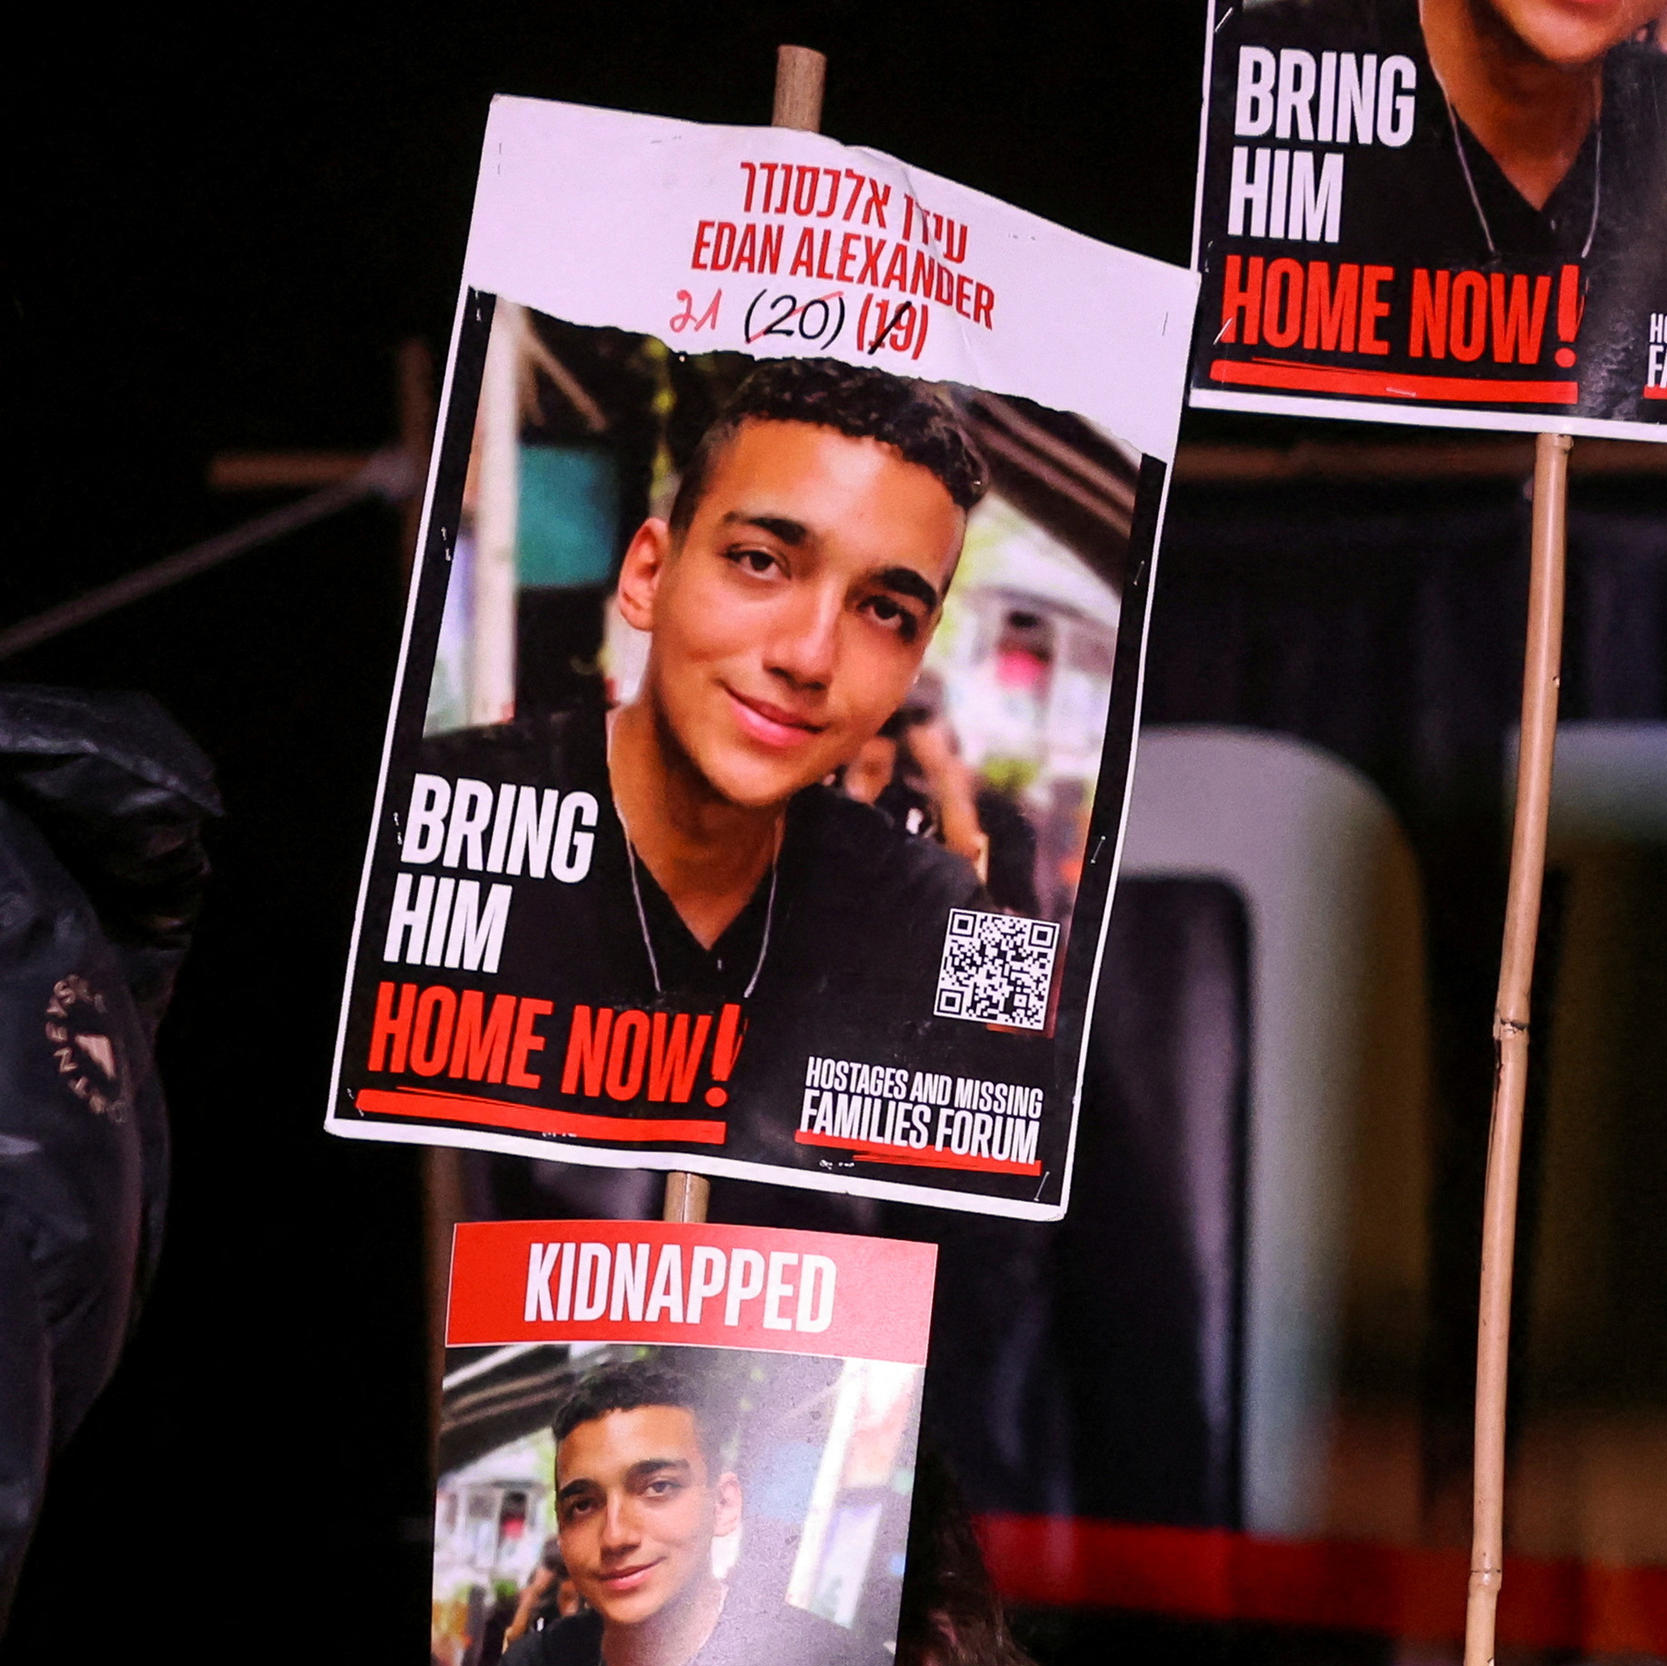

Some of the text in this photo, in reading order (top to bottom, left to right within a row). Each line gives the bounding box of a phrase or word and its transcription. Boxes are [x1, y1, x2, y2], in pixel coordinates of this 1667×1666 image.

[1233, 45, 1417, 147] BRING
[740, 161, 968, 265] עידן אלכסנדר
[1227, 149, 1345, 244] HIM
[669, 288, 845, 350] 21 (20)
[691, 220, 995, 331] EDAN ALEXANDER
[856, 292, 929, 361] (19)
[1221, 255, 1587, 369] HOME NOW!
[400, 772, 599, 884] BRING
[382, 872, 513, 974] HIM
[367, 981, 746, 1108] HOME NOW!
[805, 1056, 1044, 1119] HOSTAGES AND MISSING
[800, 1088, 1040, 1164] FAMILIES FORUM
[524, 1242, 837, 1333] KIDNAPPED
